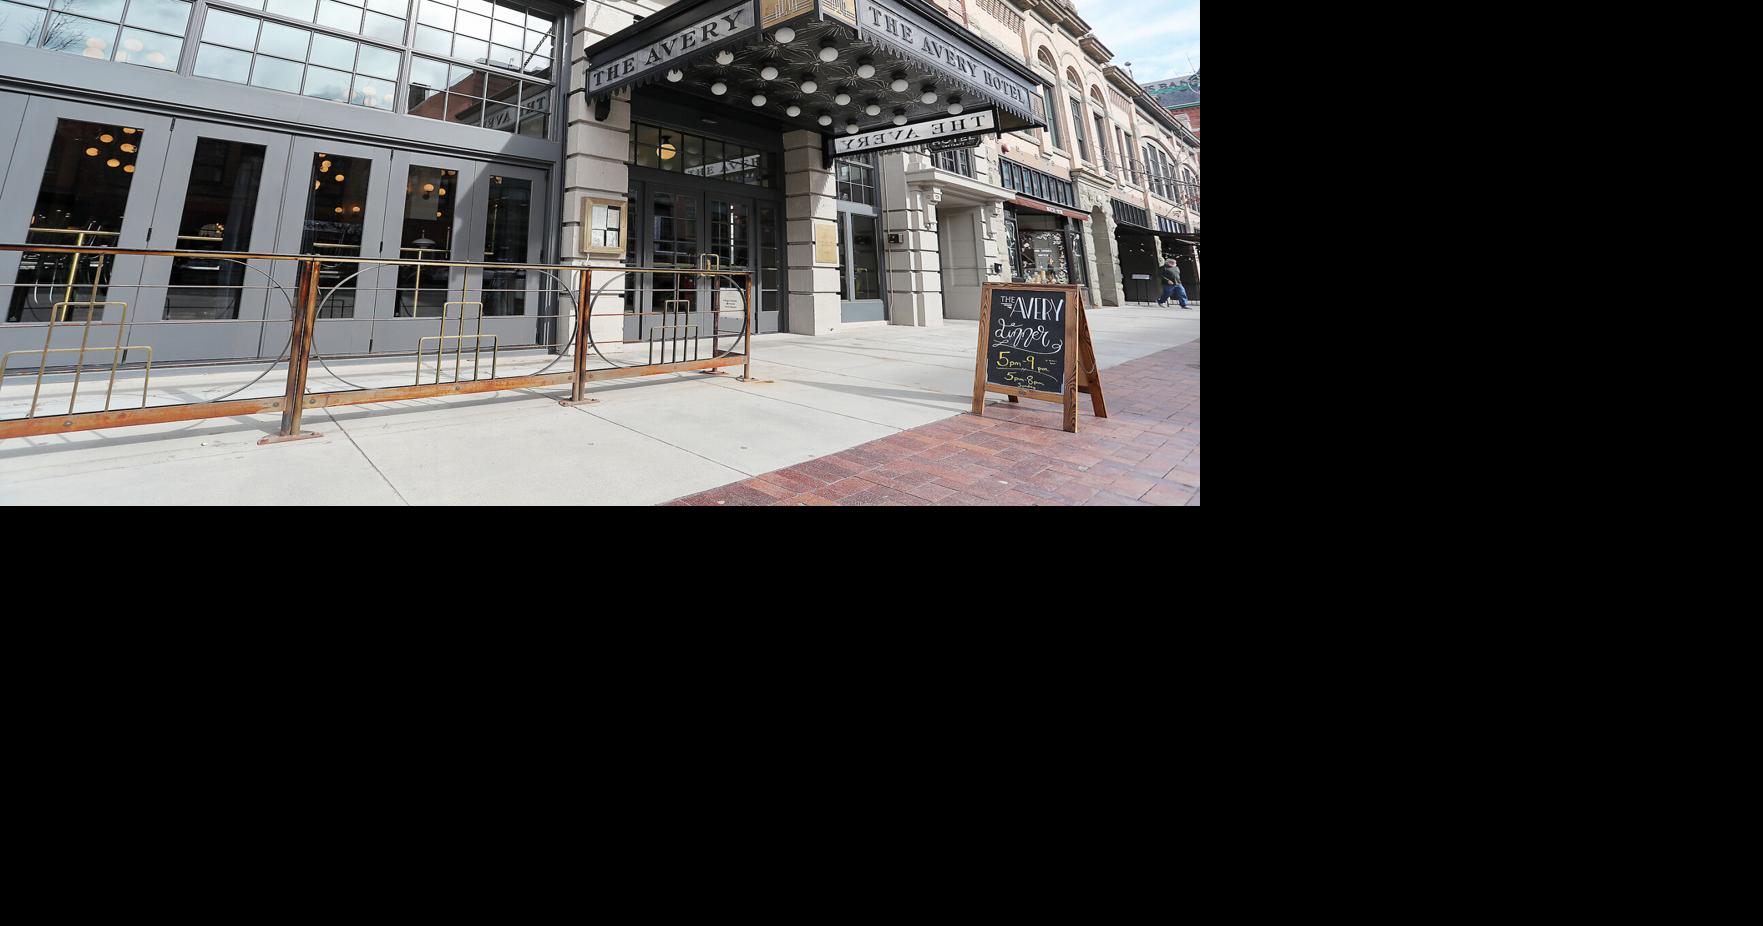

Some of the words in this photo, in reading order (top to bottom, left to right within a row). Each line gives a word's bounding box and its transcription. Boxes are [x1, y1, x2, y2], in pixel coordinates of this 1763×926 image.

[593, 57, 635, 86] THE
[645, 8, 745, 65] AVERY
[868, 6, 913, 44] THE
[921, 36, 978, 78] AVERY
[983, 70, 1025, 104] HOTEL
[1010, 296, 1064, 321] AVERY
